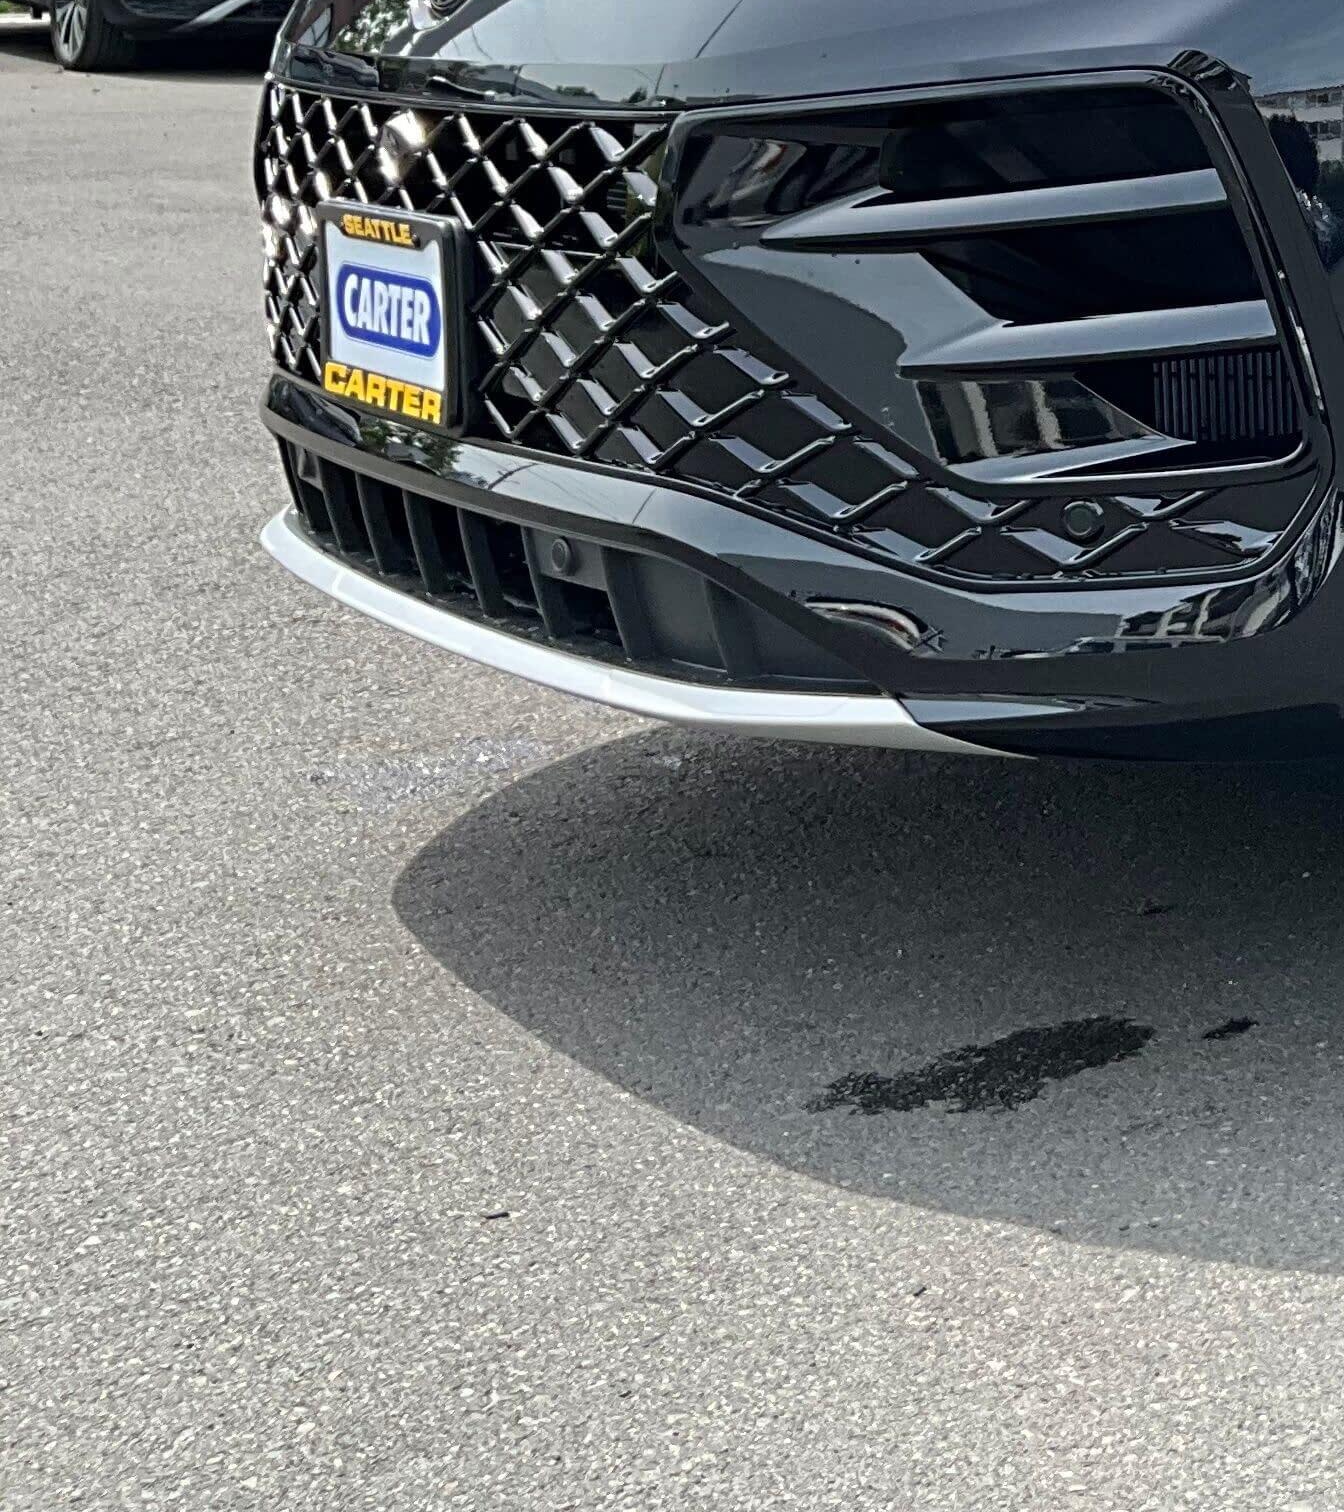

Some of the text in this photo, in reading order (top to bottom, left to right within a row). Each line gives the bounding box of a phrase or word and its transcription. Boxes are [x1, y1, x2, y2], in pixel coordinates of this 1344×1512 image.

[342, 214, 415, 247] SEATTLE
[343, 273, 431, 345] CARTER
[324, 361, 442, 425] CARTER
